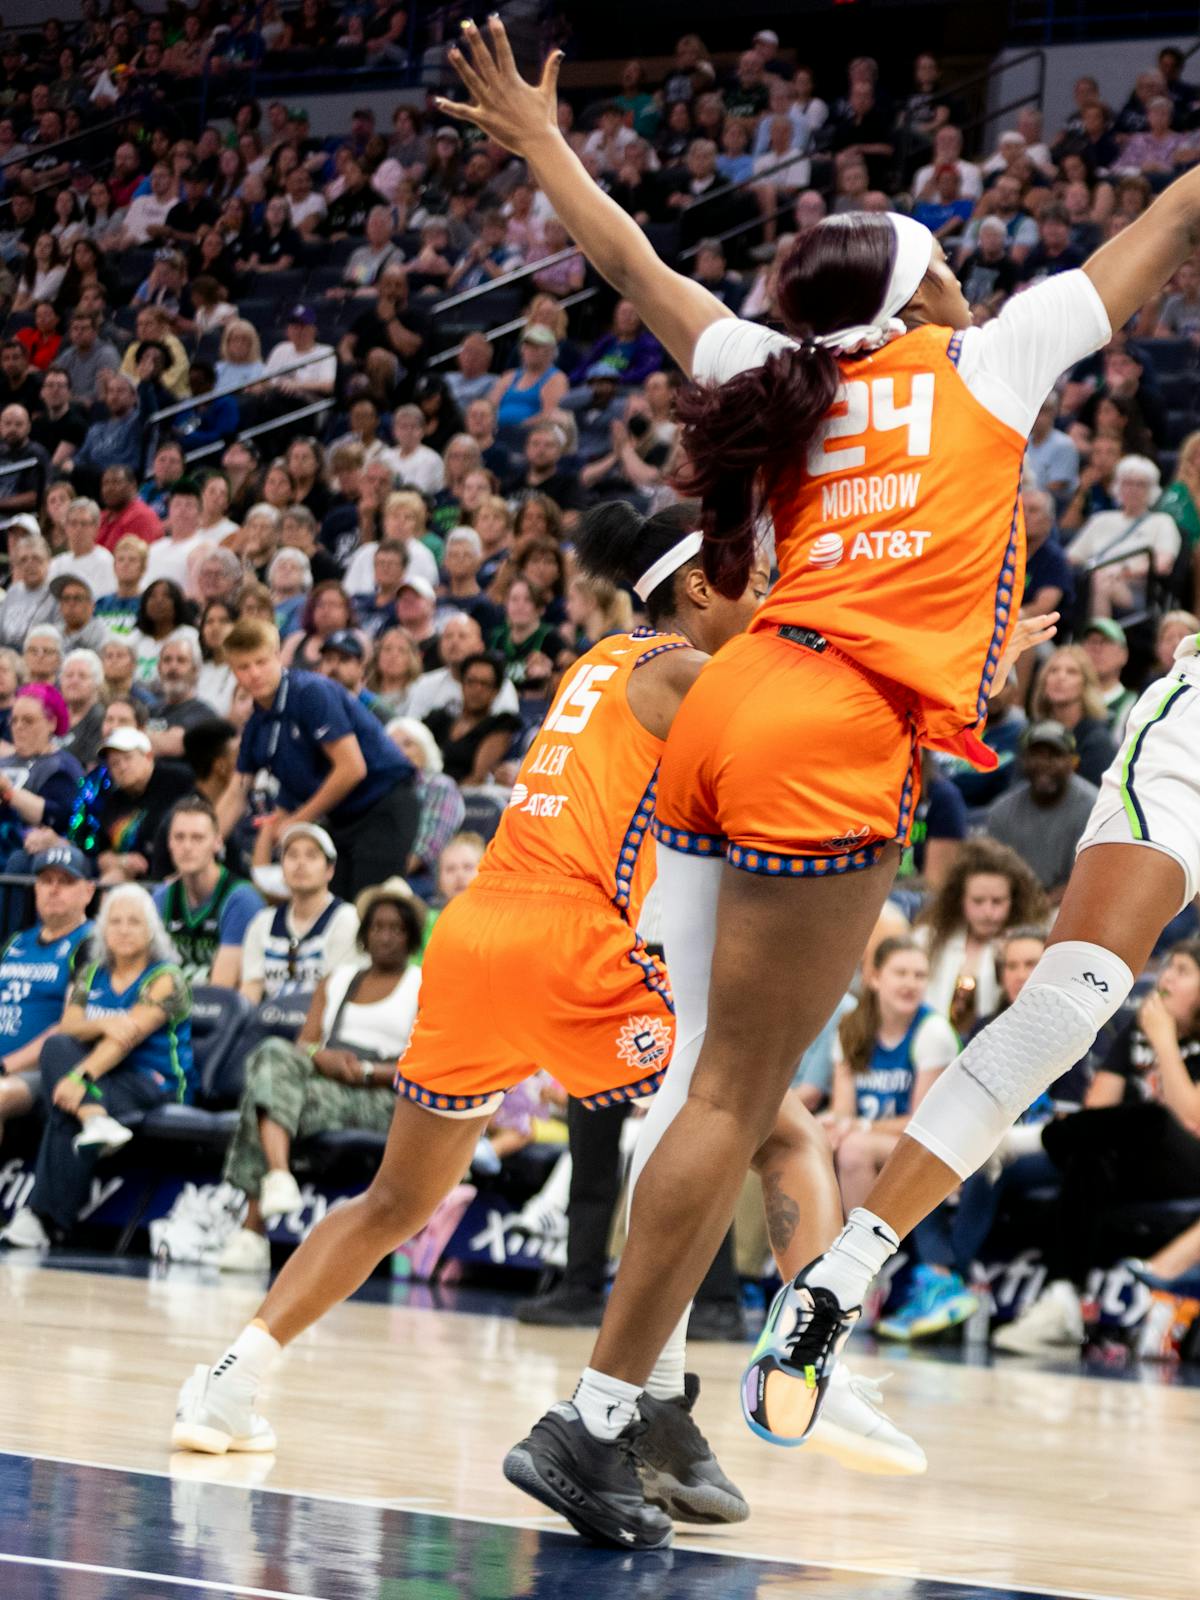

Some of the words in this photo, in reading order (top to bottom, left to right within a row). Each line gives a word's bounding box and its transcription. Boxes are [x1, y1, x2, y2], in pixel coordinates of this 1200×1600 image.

[806, 373, 935, 477] 24
[821, 472, 921, 522] MORROW
[850, 530, 932, 560] AT&T
[543, 664, 618, 735] 15
[520, 793, 569, 817] AT&T
